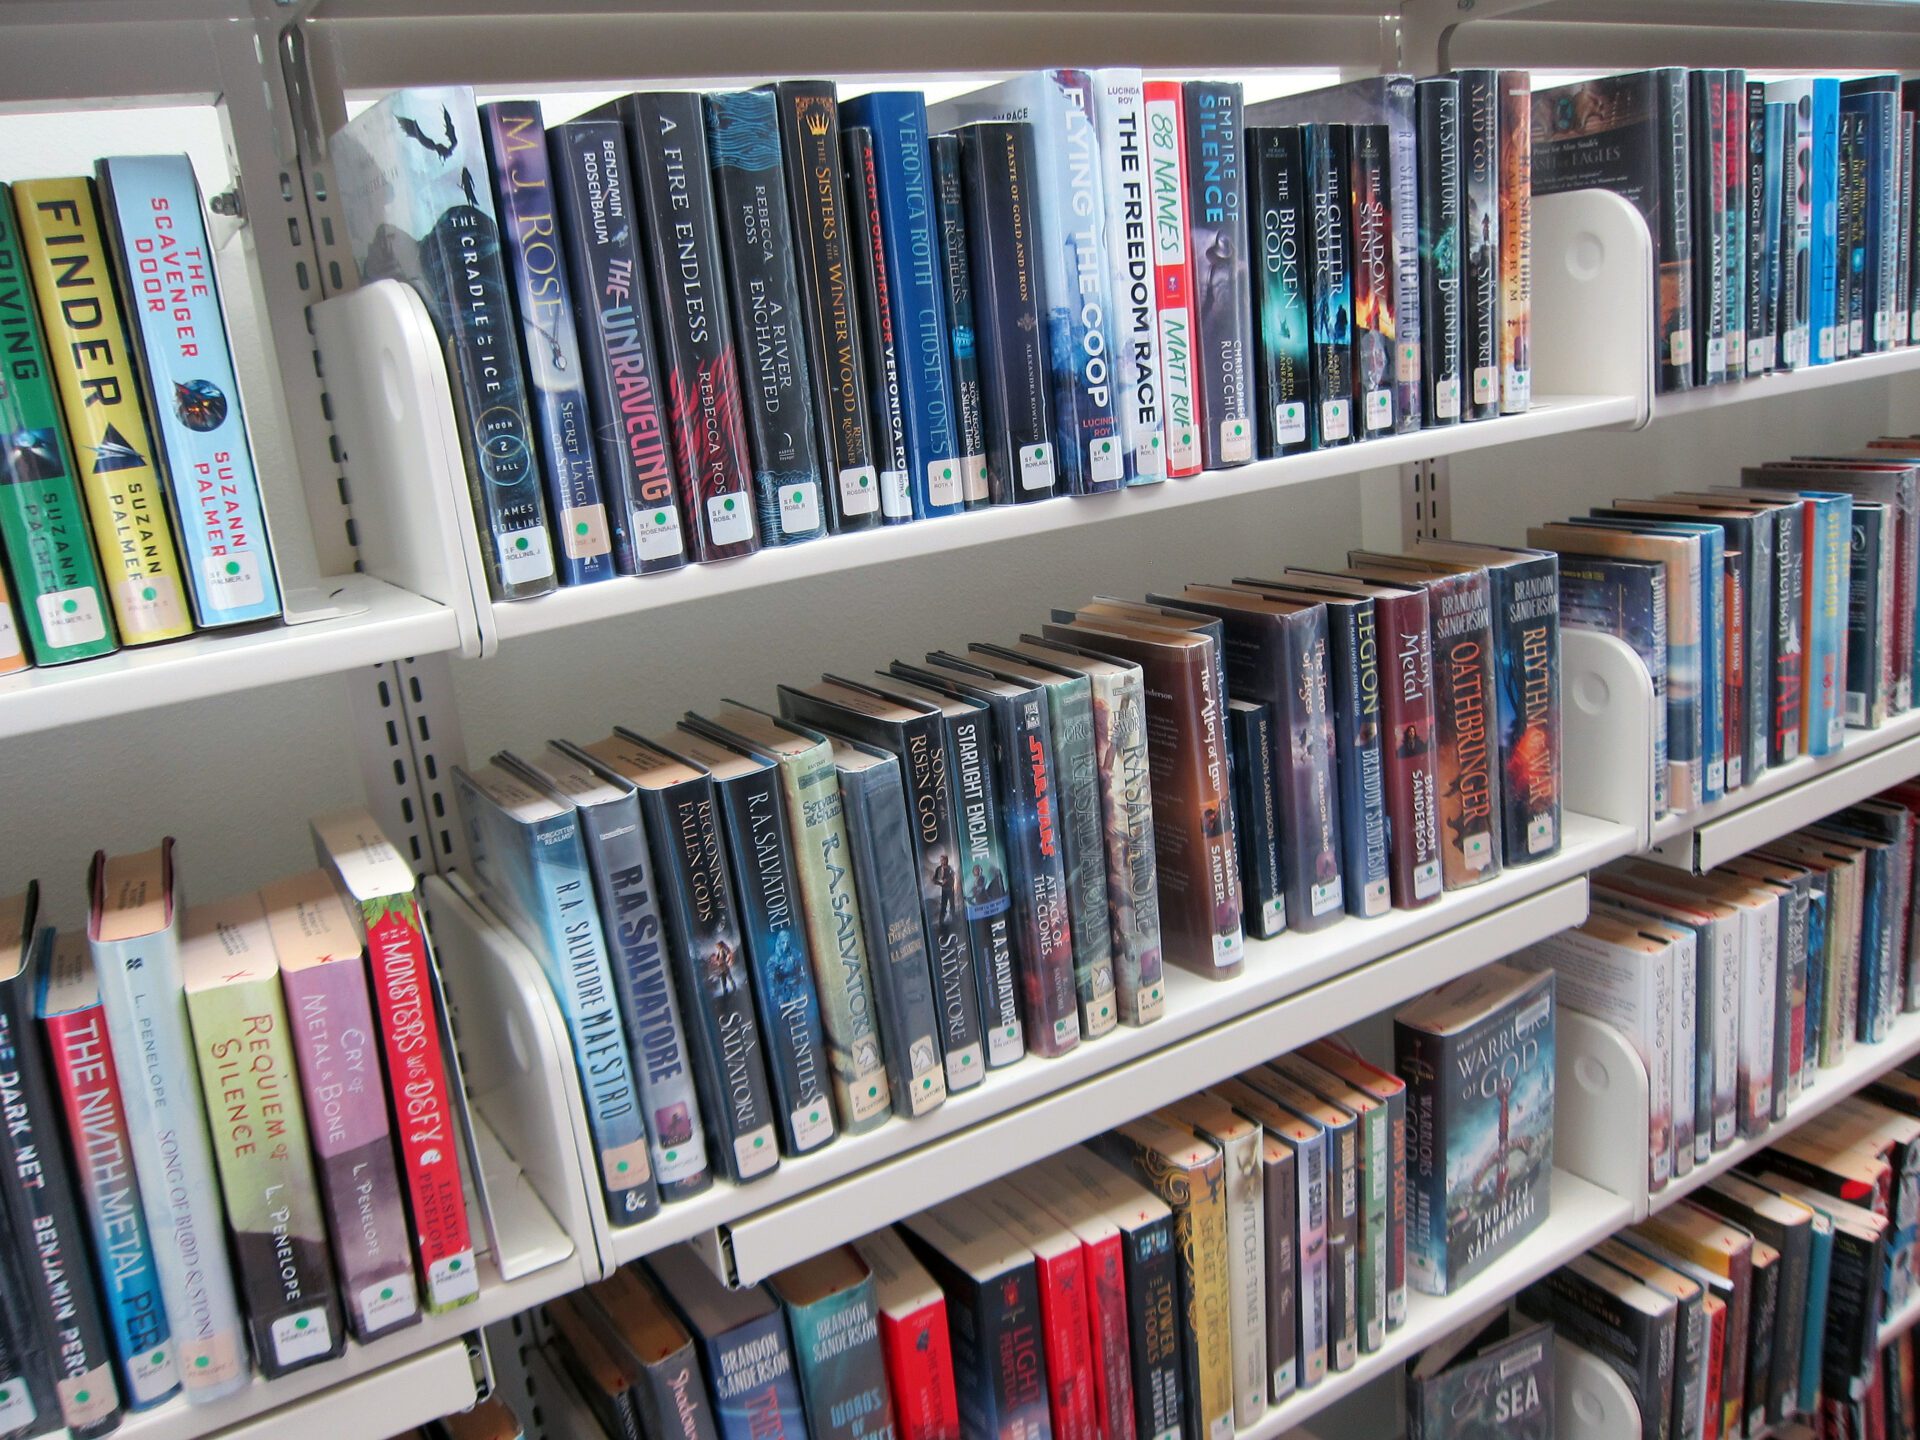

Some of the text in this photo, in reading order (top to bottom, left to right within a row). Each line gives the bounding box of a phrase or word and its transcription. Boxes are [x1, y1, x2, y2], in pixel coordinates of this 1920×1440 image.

[1107, 86, 1140, 96] LUCINDA
[1117, 97, 1134, 105] ROY
[602, 140, 624, 217] BENJAMIN
[816, 140, 828, 165] THE
[1151, 113, 1179, 254] 88 NAMES
[1199, 94, 1224, 223] SILENCE
[1217, 96, 1239, 222] EMPIRE OF
[1278, 168, 1289, 200] THE
[450, 216, 478, 228] THE
[583, 152, 609, 245] ROSENBAUM
[659, 115, 709, 344] A FIRE ENDLESS
[743, 205, 758, 245] ROSS
[755, 185, 774, 262] REBECCA
[815, 167, 837, 240] SISTERS
[898, 111, 932, 286] VERONICA ROTH
[1006, 133, 1028, 302] A TASTE OF GOLD AND IRON
[1314, 192, 1329, 275] PRAYER
[1327, 169, 1344, 296] THE GUTTER
[1359, 202, 1373, 265] SAINT
[1371, 168, 1388, 299] THE SHADOW
[1400, 166, 1415, 239] SALVATORE
[134, 237, 166, 313] DOOR
[150, 197, 198, 358] SCAVENGER
[183, 246, 208, 298] THE
[519, 214, 564, 317] ROSE
[606, 258, 632, 300] THE
[1063, 87, 1108, 408] FLYING THE COOP
[1118, 111, 1156, 425] THE FREEDOM RACE
[1264, 209, 1282, 273] GOD
[1279, 208, 1299, 309] BROKEN
[1751, 163, 1761, 330] GEORGE MARTIN
[37, 200, 122, 409] FINDER
[461, 236, 490, 327] CRADLE
[864, 147, 902, 442] ARCH-CONSPIRATOR VERONICA
[1712, 281, 1722, 335] SMALE
[477, 335, 495, 346] OF
[482, 355, 501, 393] ICE
[750, 280, 780, 413] ENCHANTED
[770, 301, 792, 390] A RIVER
[828, 263, 857, 413] WINTER WOOD
[1163, 319, 1188, 388] MATT
[600, 304, 673, 502] UNRAVELING
[700, 372, 723, 454] REBECCA
[918, 308, 947, 455] CHOSEN ONES
[968, 380, 977, 408] SLOW
[1026, 343, 1039, 441] ALEXANDRA ROWLAND
[1221, 340, 1236, 422] RUOCCHIO
[487, 421, 513, 432] MOON
[500, 441, 508, 452] 2
[560, 401, 579, 455] SECRET
[843, 418, 856, 464] ROSSNER
[853, 426, 863, 454] RENA
[1082, 416, 1119, 428] LUCINDA
[1094, 427, 1111, 437] ROY
[496, 463, 519, 472] FALL
[498, 503, 534, 518] JAMES
[1441, 587, 1484, 617] BRANDON
[1509, 592, 1559, 624] SANDERSON
[1514, 574, 1554, 601] BRANDON
[1776, 517, 1793, 640] Stephenson
[1437, 606, 1490, 639] SANDERSON
[1298, 675, 1314, 715] Ages
[1357, 609, 1379, 716] LEGION
[1399, 632, 1424, 703] Metal
[1522, 625, 1549, 727] RHYTHM
[1200, 666, 1217, 744] The Alloy
[1450, 641, 1492, 827] OATHBRINGER
[1776, 653, 1802, 752] FALL
[909, 734, 939, 844] RISEN GOD
[930, 748, 949, 801] SONG
[957, 724, 983, 800] STARLIGHT
[1028, 735, 1055, 857] STAR WARS
[1259, 720, 1275, 841] BRANDON SANDERSON
[1362, 749, 1382, 809] BRANDON
[536, 825, 575, 842] FORGOTTEN
[543, 831, 575, 846] REALMS
[697, 800, 727, 898] RECKONING
[966, 801, 990, 863] ENCLAVE
[1412, 769, 1427, 862] SANDERSON
[1424, 774, 1436, 850] BRANDON
[678, 801, 713, 923] FALLEN GODS
[754, 831, 792, 934] SALVATORE
[1034, 874, 1053, 958] THE CLONES
[1045, 875, 1063, 948] ATTACK OF
[565, 920, 633, 1121] SALVATORE MAESTRO
[617, 913, 683, 1086] SALVATORE
[938, 933, 968, 1043] SALVATORE
[140, 1017, 168, 1109] PENELOPE
[302, 994, 347, 1145] METAL BONE
[340, 1028, 367, 1093] CRY OF
[381, 939, 444, 1145] MONSTERS DEFY
[718, 1011, 757, 1130] SALVATORE
[1480, 1038, 1538, 1099] GOD
[210, 1036, 257, 1159] SILENCE
[242, 1014, 290, 1161] REQUIEM OF
[63, 1019, 146, 1293] THE NINTH METAL
[157, 1128, 190, 1211] SONG OF
[15, 1144, 77, 1323] NET BENJAMIN
[265, 1183, 302, 1302] L. PENELOPE
[352, 1161, 381, 1258] L. PENELOPE
[419, 1172, 446, 1259] PENELOPE
[438, 1180, 460, 1244] LESLYE
[1466, 1195, 1536, 1265] SAPKOWSKI
[1476, 1181, 1530, 1237] ANDRZEJ
[816, 1301, 869, 1340] BRANDON
[1156, 1281, 1175, 1359] TOWER
[1200, 1217, 1221, 1370] SECRET CIRCUS
[716, 1349, 790, 1401] SANDERSON
[719, 1331, 778, 1376] BRANDON
[812, 1319, 878, 1364] SANDERSON
[1013, 1325, 1041, 1404] LIGHT
[830, 1388, 883, 1429] WORDS
[1495, 1372, 1540, 1424] SEA
